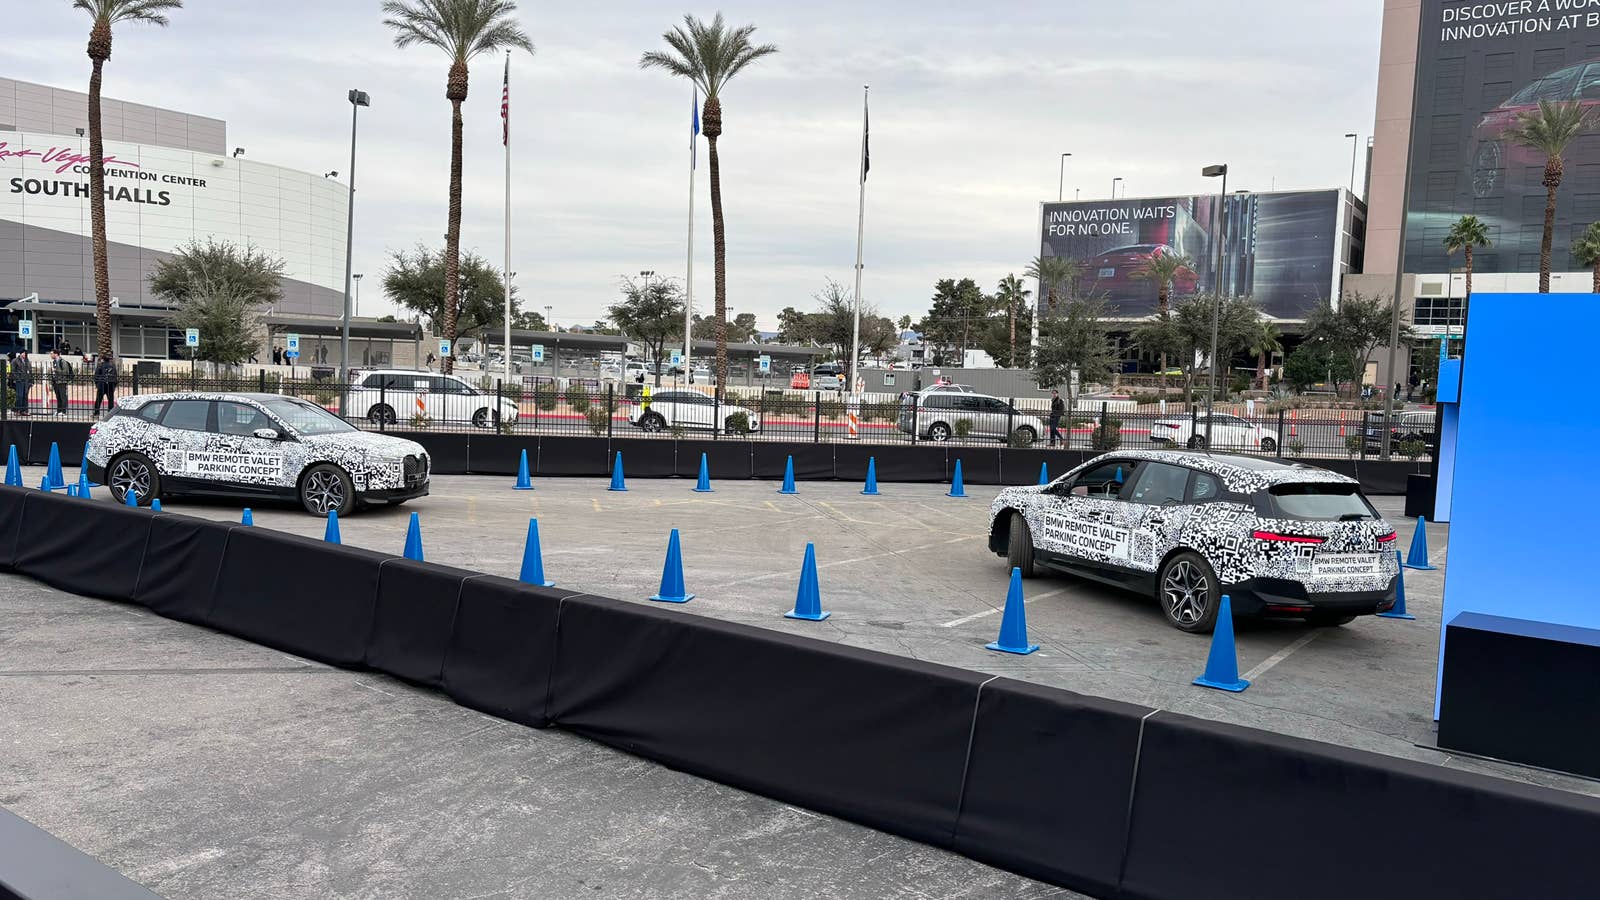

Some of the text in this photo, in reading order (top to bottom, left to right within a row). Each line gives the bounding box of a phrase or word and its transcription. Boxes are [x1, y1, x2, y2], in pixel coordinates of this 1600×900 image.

[1442, 0, 1532, 22] DISCOVER
[1536, 0, 1550, 12] A
[1441, 12, 1600, 41] INNOVATION AT B
[73, 165, 207, 188] COVENTION CENTER
[10, 177, 171, 206] SOUTH HALLS
[1049, 205, 1175, 223] INNOVATION WAITS
[1048, 222, 1133, 236] FOR NO ONE.
[188, 453, 280, 466] BMW REMOTE VALET
[198, 463, 280, 475] PARKING CONCEPT
[1045, 515, 1127, 543] BMW REMOTE VALET
[1045, 527, 1116, 553] PARKING CONCEPT
[1314, 556, 1376, 565] BMW REMOTE VALET
[1318, 566, 1346, 574] PARKING
